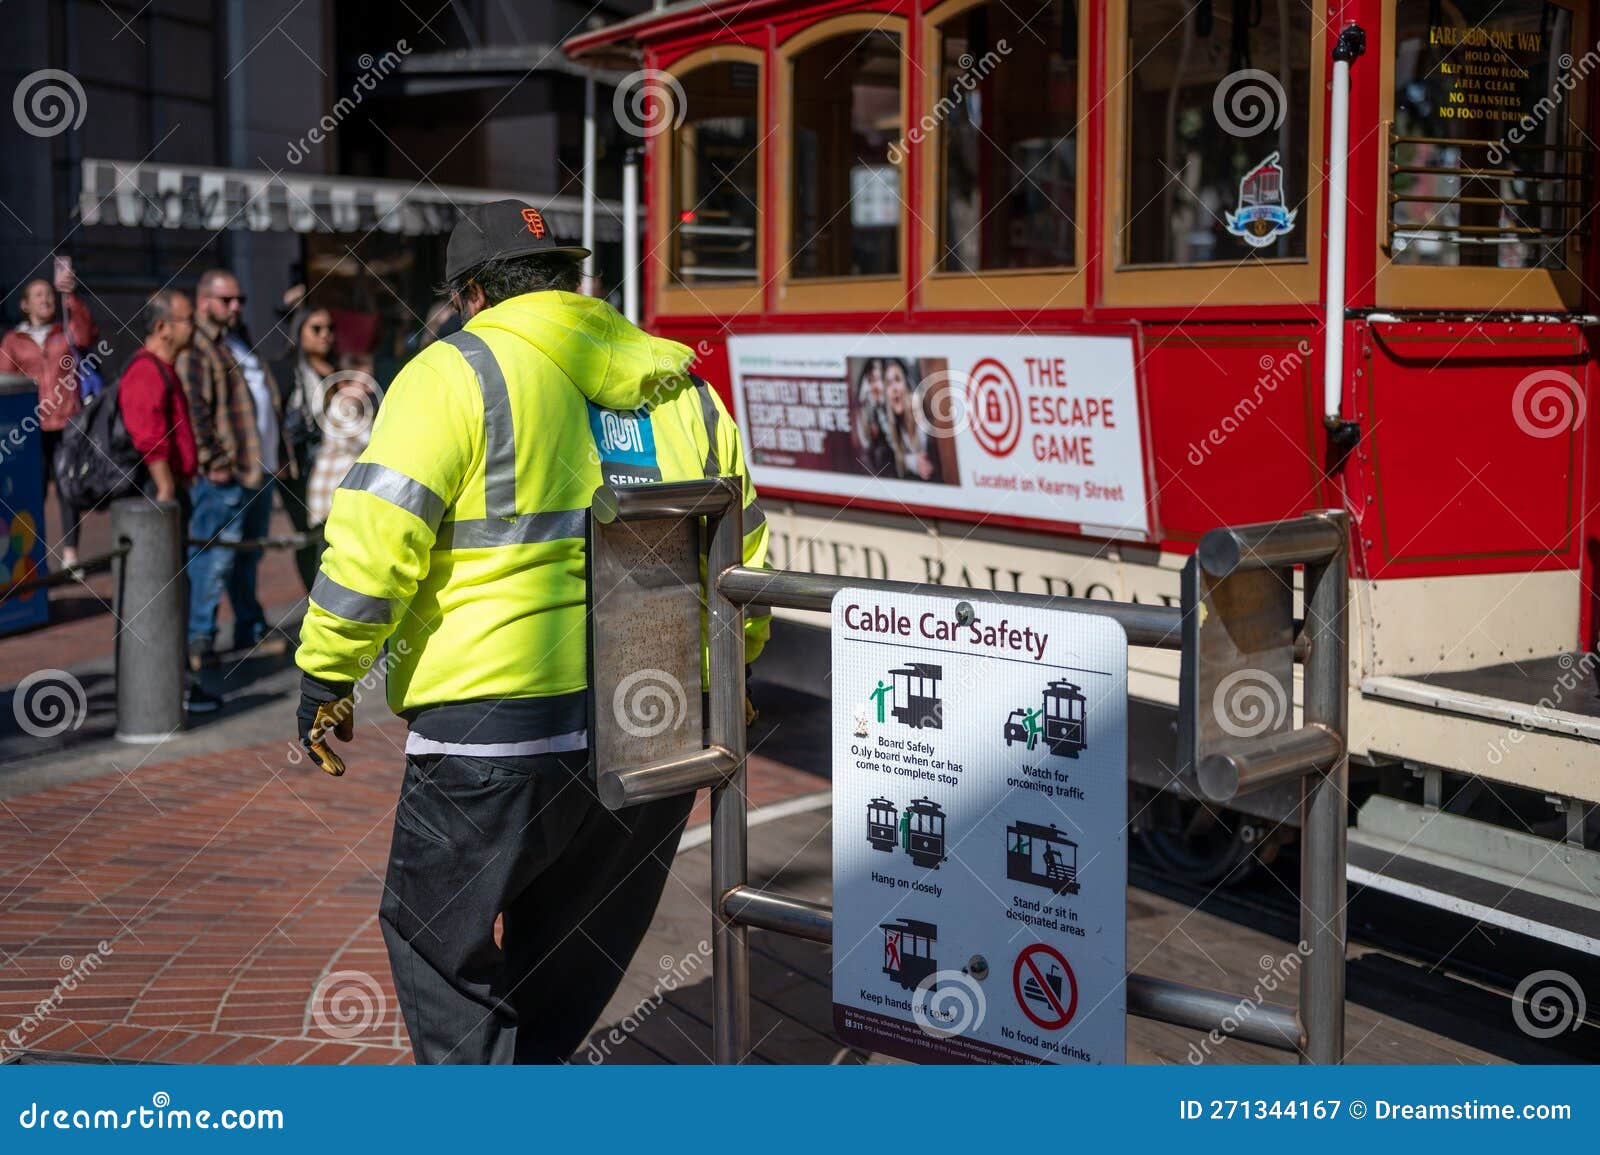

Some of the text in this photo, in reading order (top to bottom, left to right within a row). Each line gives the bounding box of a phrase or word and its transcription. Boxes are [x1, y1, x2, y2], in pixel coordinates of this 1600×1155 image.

[1491, 30, 1514, 49] ONE
[1517, 32, 1542, 52] WAY
[1465, 51, 1507, 63] HOLD ON
[1441, 63, 1529, 79] KEEP YELLOW FLOOR
[1455, 79, 1516, 91] AREA CLEAR
[1449, 92, 1521, 106] NO TRANSFERS
[1440, 106, 1454, 118] NO
[1457, 108, 1483, 119] FOOD
[1486, 110, 1498, 120] OR
[1024, 357, 1068, 388] THE
[1028, 396, 1116, 429] ESCAPE
[1032, 433, 1095, 467] GAME
[972, 470, 1125, 501] Located on Kearny Street
[769, 530, 888, 581] ITED
[844, 603, 1049, 661] Cable Car Safety
[878, 736, 935, 757] Board Safely
[874, 748, 900, 761] board
[903, 754, 929, 767] when
[931, 760, 945, 770] car
[947, 760, 963, 773] has
[856, 760, 958, 787] come to complete stop
[1022, 764, 1069, 783] Watch for
[1007, 777, 1085, 800] oncoming traffic
[871, 871, 943, 898] Hang on closely
[1013, 896, 1078, 921] Stand or sit in
[1006, 908, 1086, 937] designated areas
[860, 989, 883, 1004] Keep
[885, 995, 912, 1012] hands
[914, 1002, 928, 1015] off
[1001, 1026, 1091, 1062] No food and drinks
